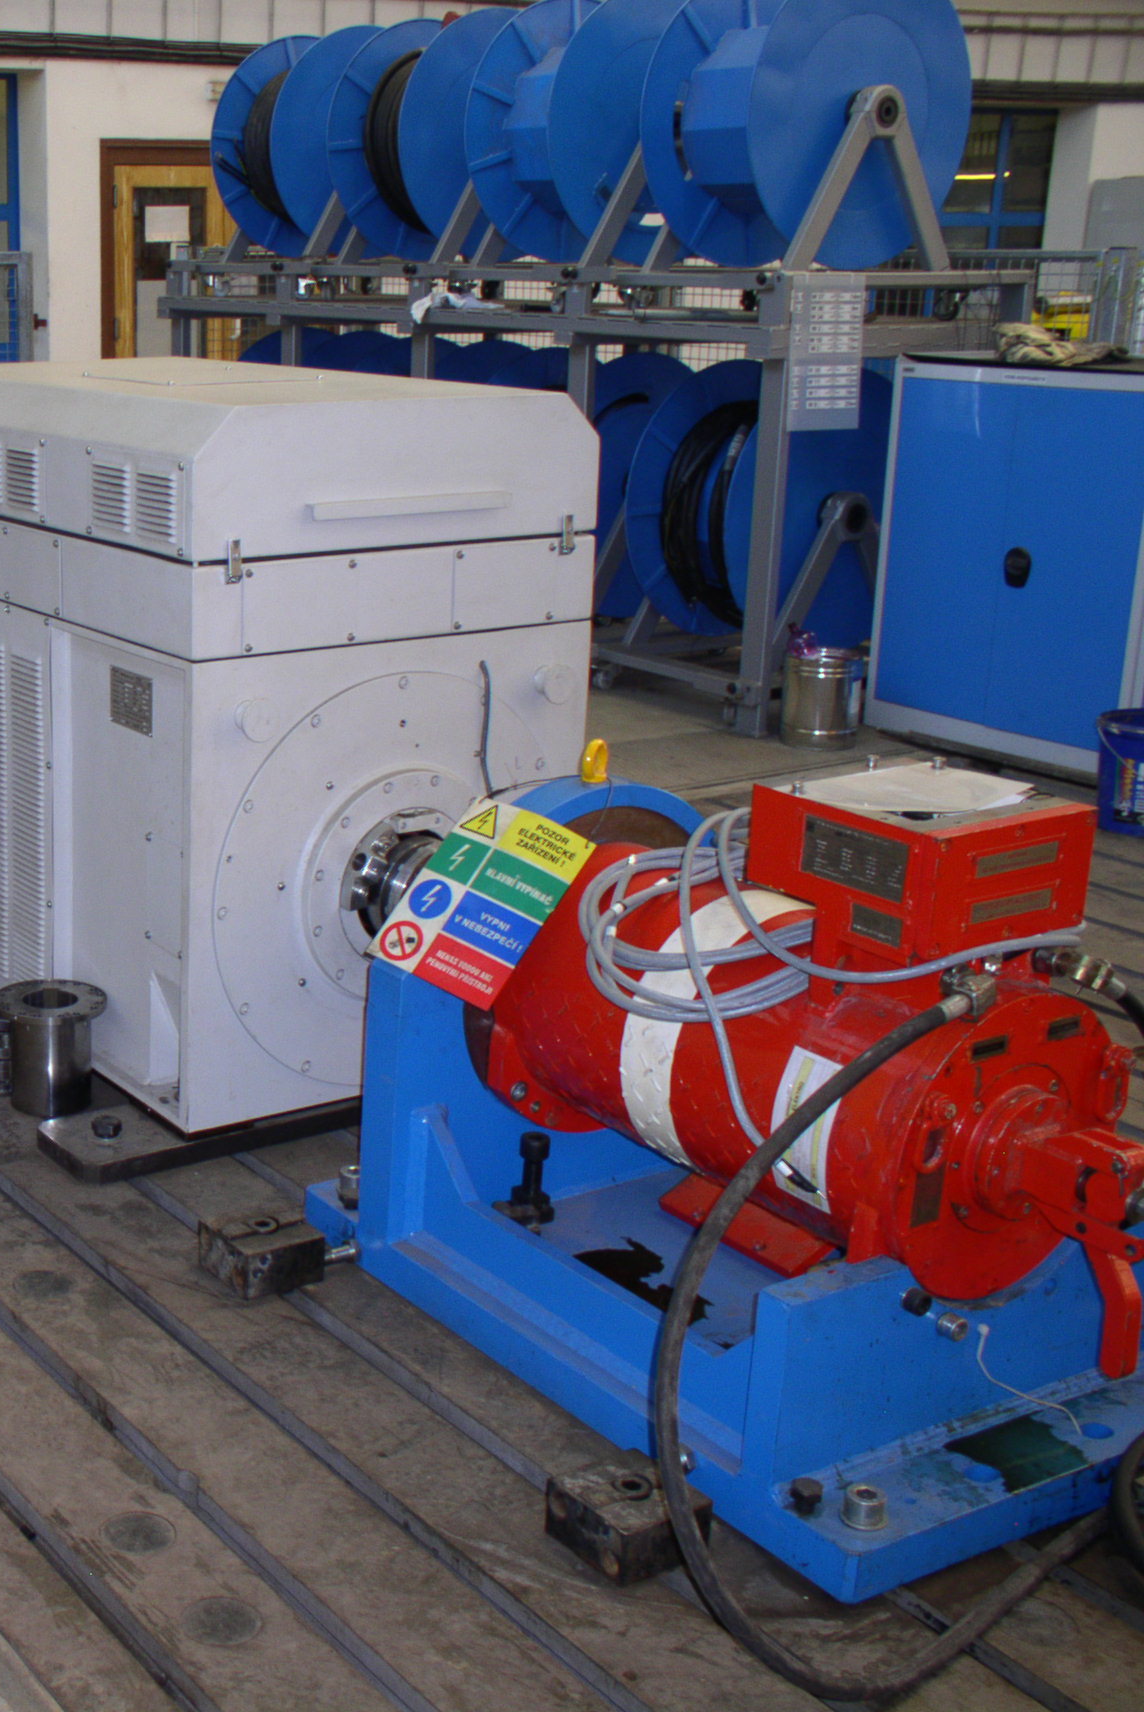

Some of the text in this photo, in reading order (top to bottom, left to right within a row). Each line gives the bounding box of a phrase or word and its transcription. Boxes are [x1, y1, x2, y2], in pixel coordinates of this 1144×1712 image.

[518, 828, 577, 861] ELEKTRICKÉ
[536, 824, 570, 845] POZOR
[461, 918, 518, 949] NEBEZPEČÍ
[480, 912, 511, 931] VYPNI
